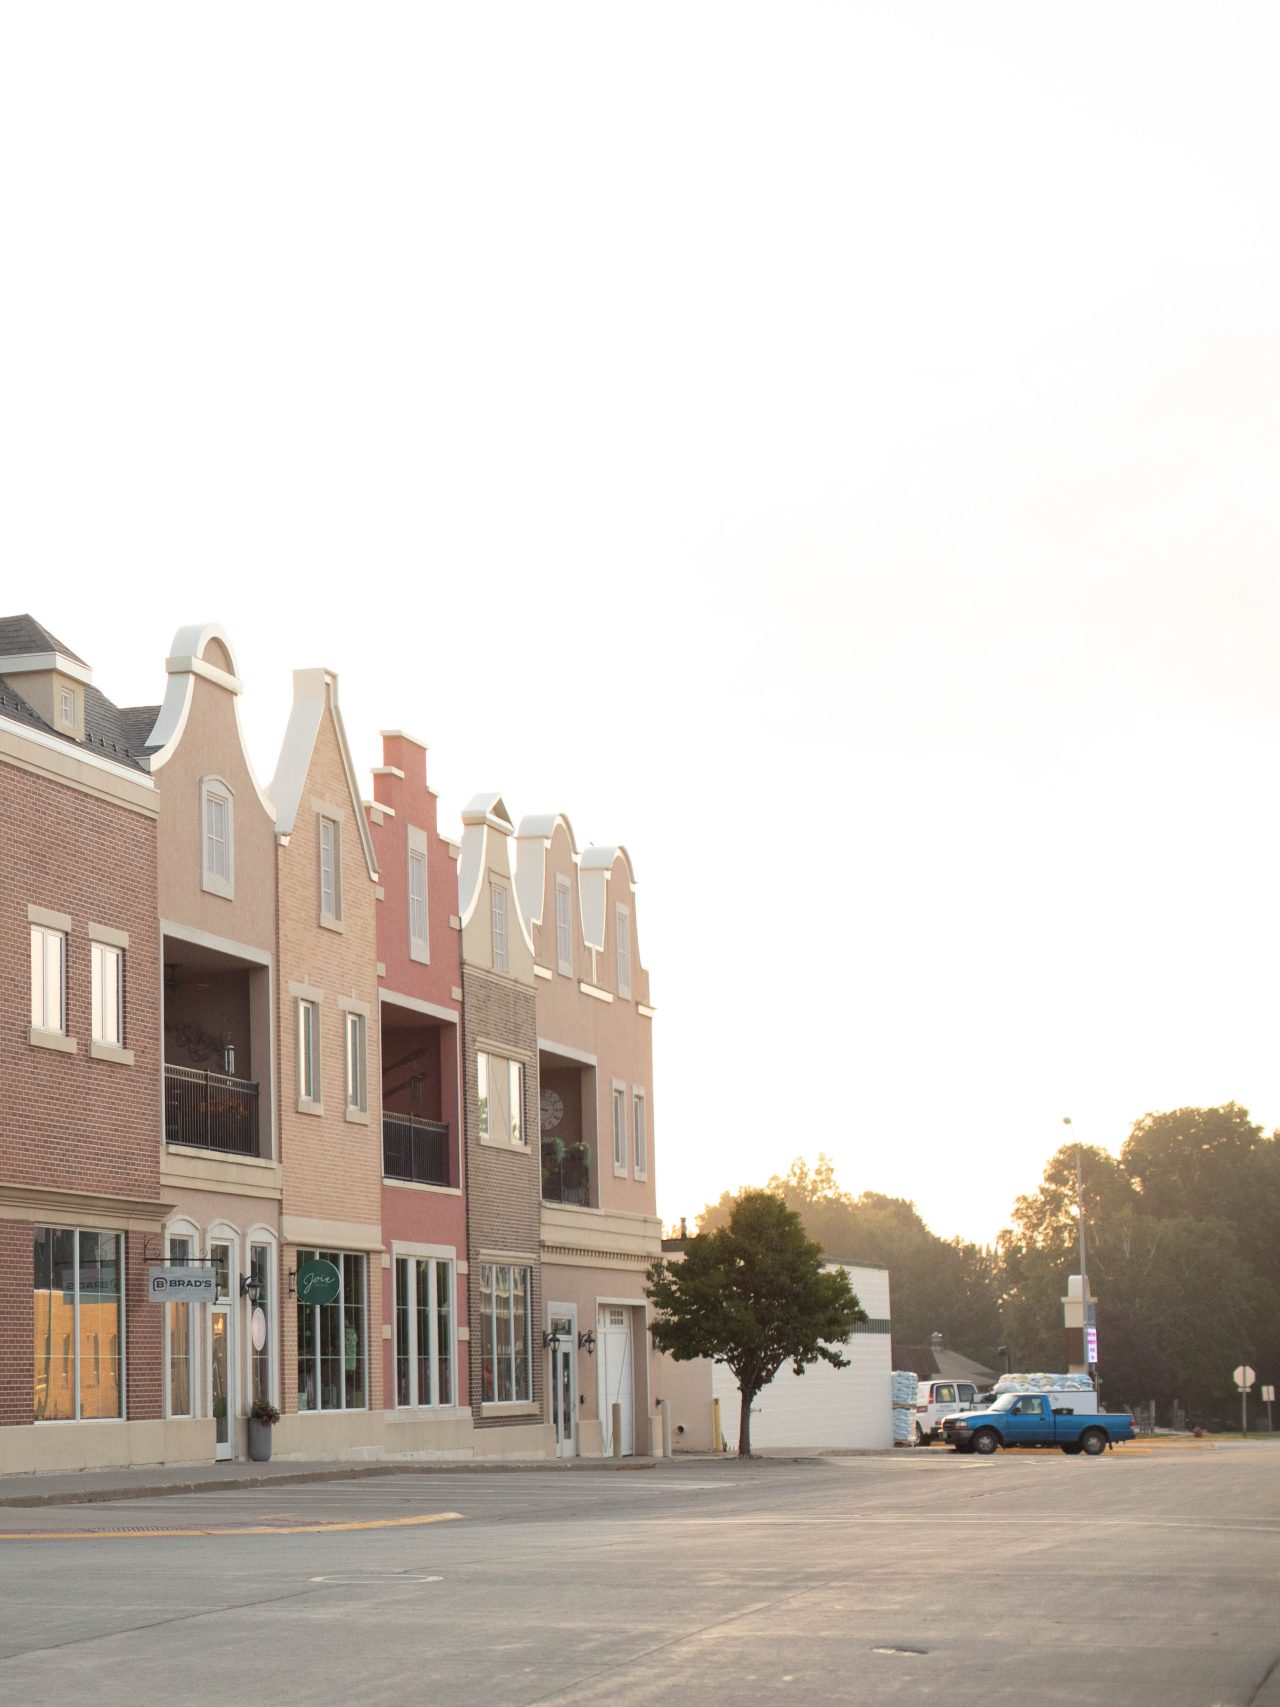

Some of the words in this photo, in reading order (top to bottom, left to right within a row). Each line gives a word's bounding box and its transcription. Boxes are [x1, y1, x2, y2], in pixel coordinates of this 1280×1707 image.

[156, 1280, 164, 1288] B
[169, 1280, 212, 1288] BRAD'S
[303, 1272, 336, 1295] Joie
